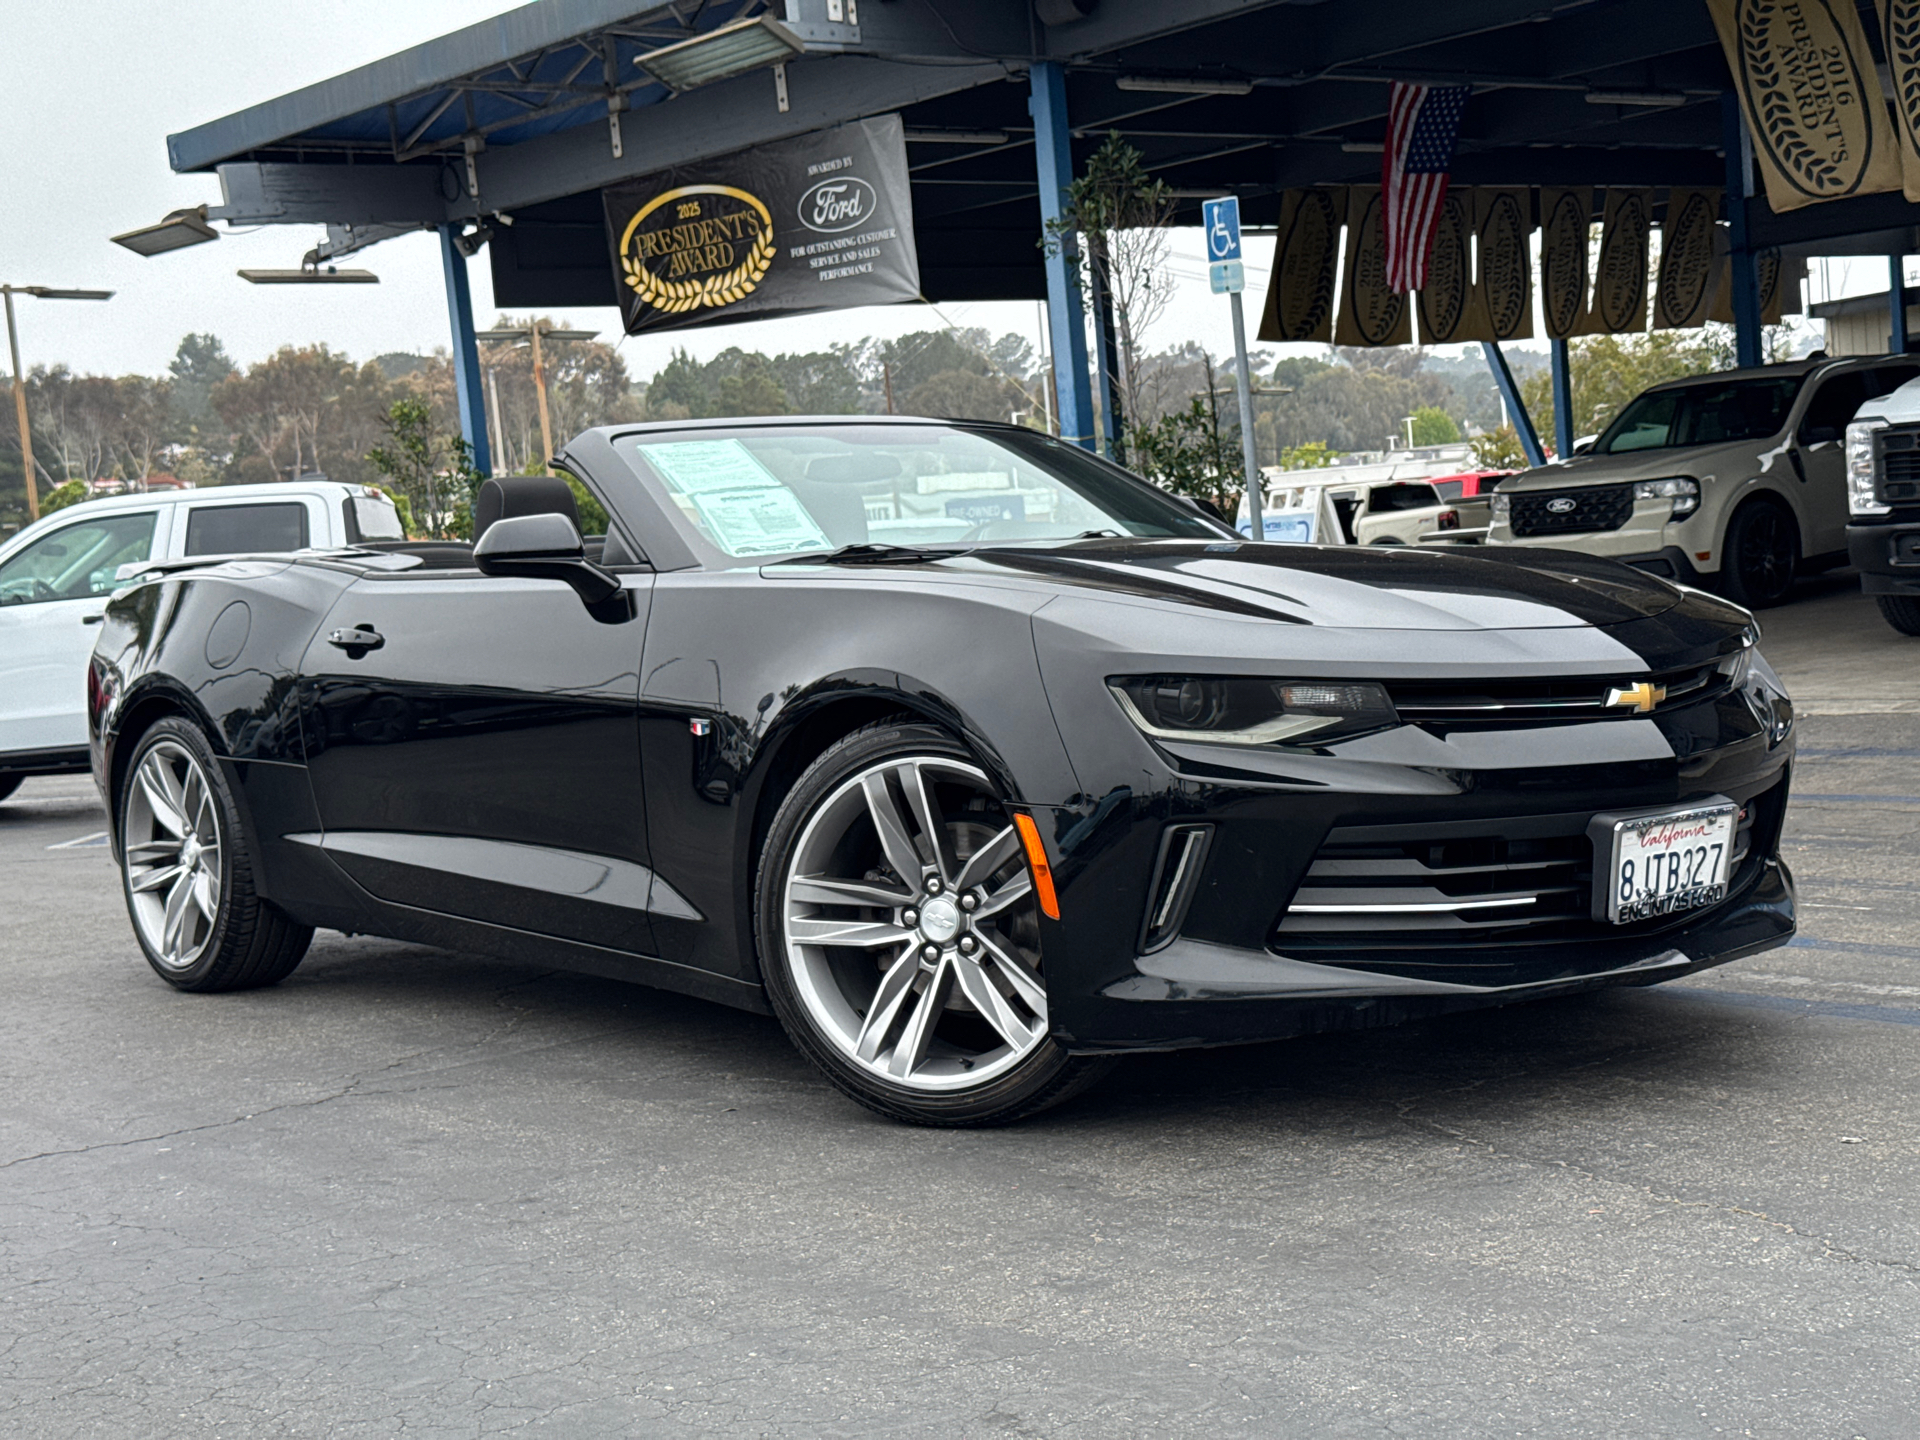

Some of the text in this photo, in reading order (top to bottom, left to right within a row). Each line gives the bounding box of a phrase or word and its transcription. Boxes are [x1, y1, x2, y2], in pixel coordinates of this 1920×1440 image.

[1776, 43, 1819, 130] AWARD
[1780, 1, 1848, 164] PRESIDENT'S
[1821, 45, 1854, 106] 2016
[808, 155, 853, 176] AWARDED BY
[677, 201, 701, 219] 2025
[813, 184, 863, 225] Ford
[634, 209, 760, 259] PRESIDENT'S
[790, 228, 897, 259] FOR OUTSTANDING CUSTOMER
[668, 242, 734, 278] AWARD
[809, 246, 881, 269] SERVICE AND SALES
[819, 262, 874, 281] PERFORMANCE
[1360, 249, 1372, 287] 2022
[1605, 246, 1620, 279] 2018
[1640, 823, 1712, 850] California
[1620, 843, 1724, 901] 8JTB327
[1618, 885, 1723, 923] ENCINITAS FORD
